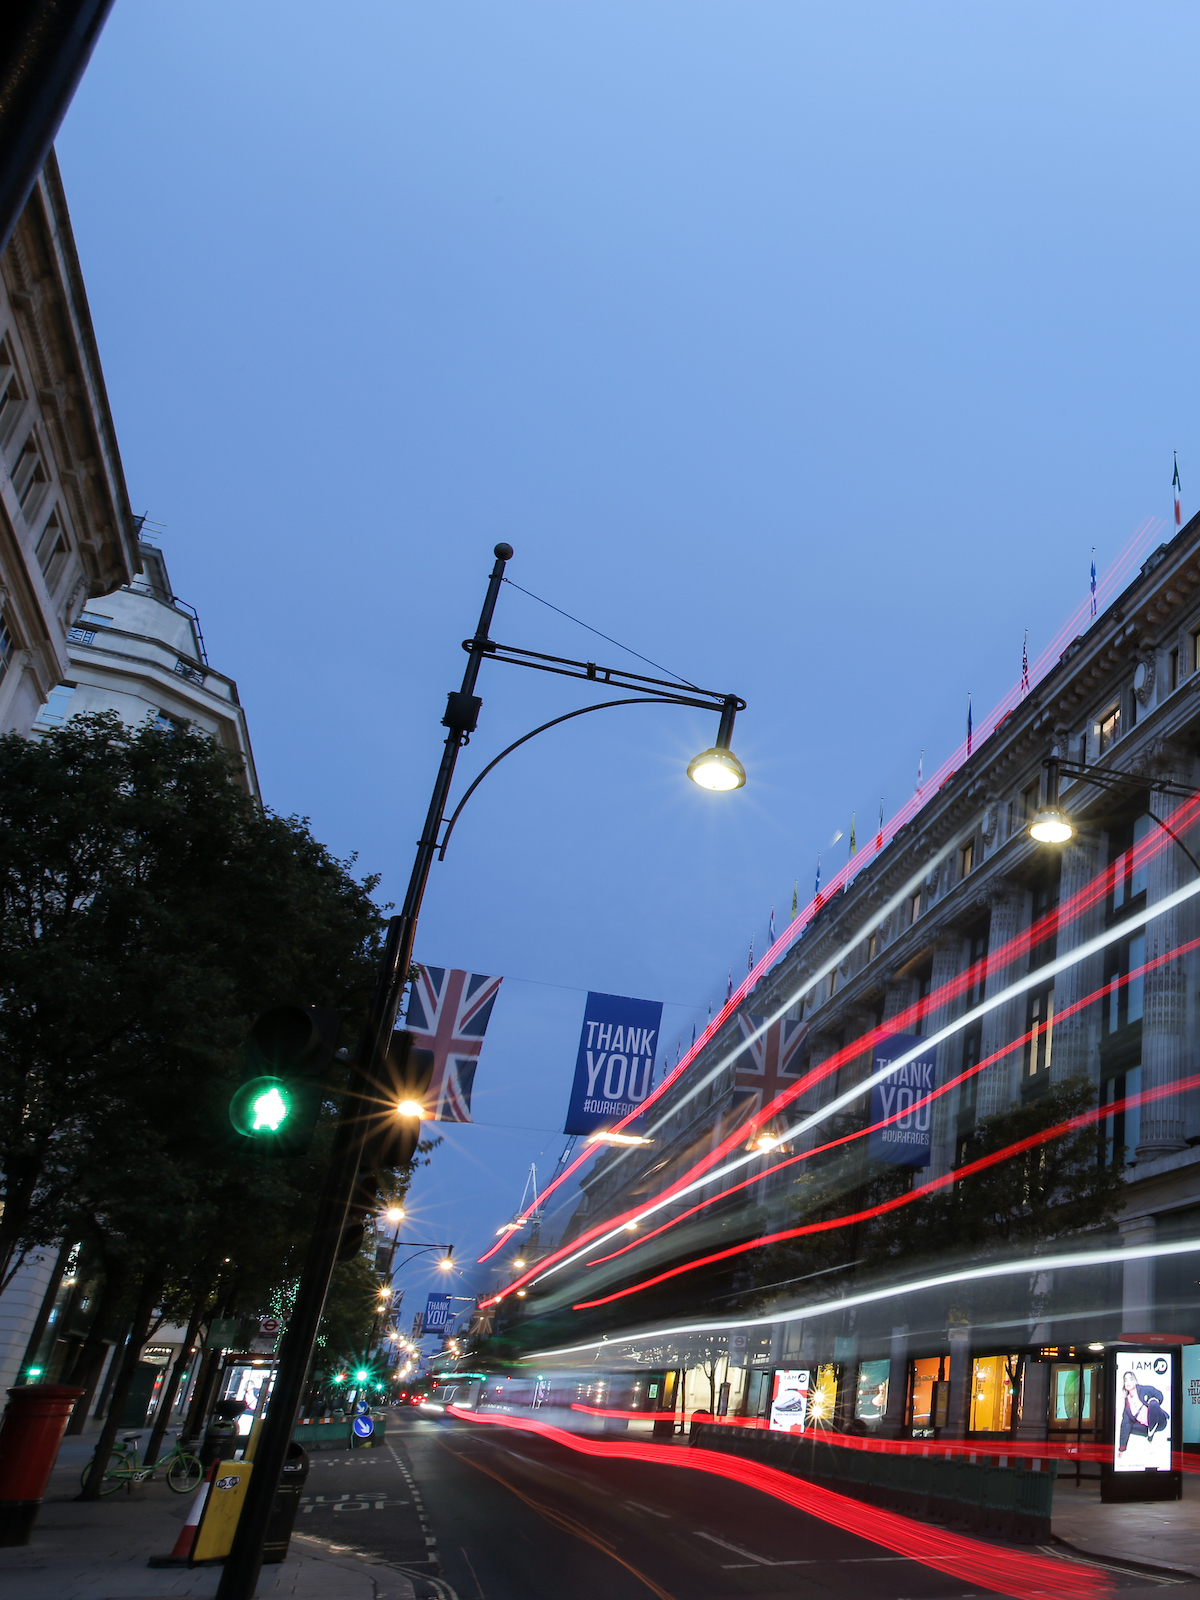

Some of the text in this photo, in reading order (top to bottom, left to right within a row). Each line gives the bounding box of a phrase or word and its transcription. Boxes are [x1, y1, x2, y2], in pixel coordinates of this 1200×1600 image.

[586, 1020, 656, 1057] THANK
[586, 1050, 652, 1102] YOU
[876, 1058, 933, 1089] THANK
[583, 1099, 645, 1118] #OURHERO
[879, 1085, 932, 1131] YOU
[427, 1301, 450, 1311] THANK
[426, 1310, 448, 1325] YOU
[1136, 1361, 1152, 1370] AM
[299, 1501, 410, 1513] TOP
